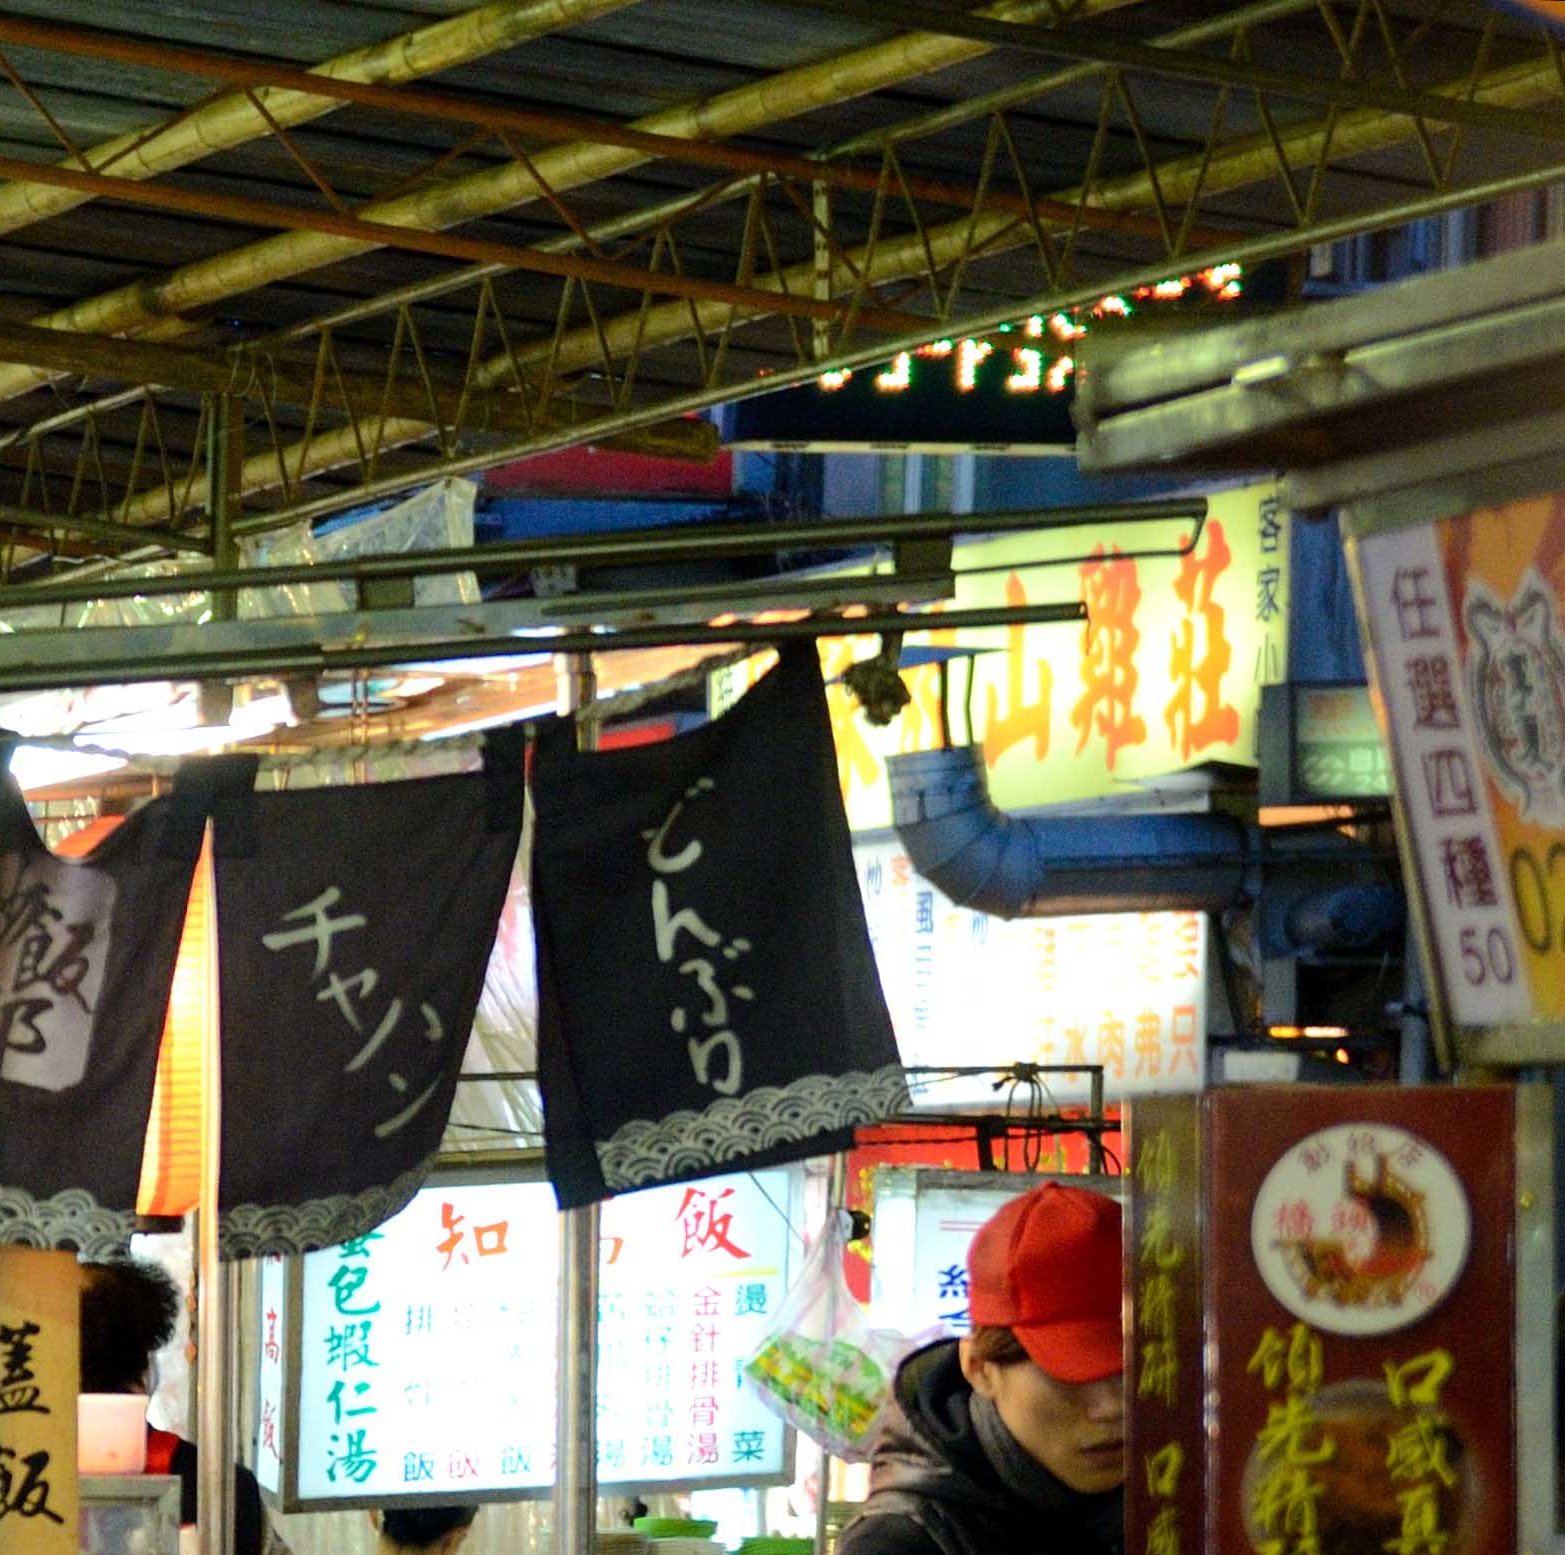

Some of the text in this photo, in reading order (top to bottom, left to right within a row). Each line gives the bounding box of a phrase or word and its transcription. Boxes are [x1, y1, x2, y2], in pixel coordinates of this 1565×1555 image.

[641, 776, 755, 1097] どんぶり
[688, 1286, 720, 1466] 金針排骨湯
[733, 1283, 768, 1464] 燙菜
